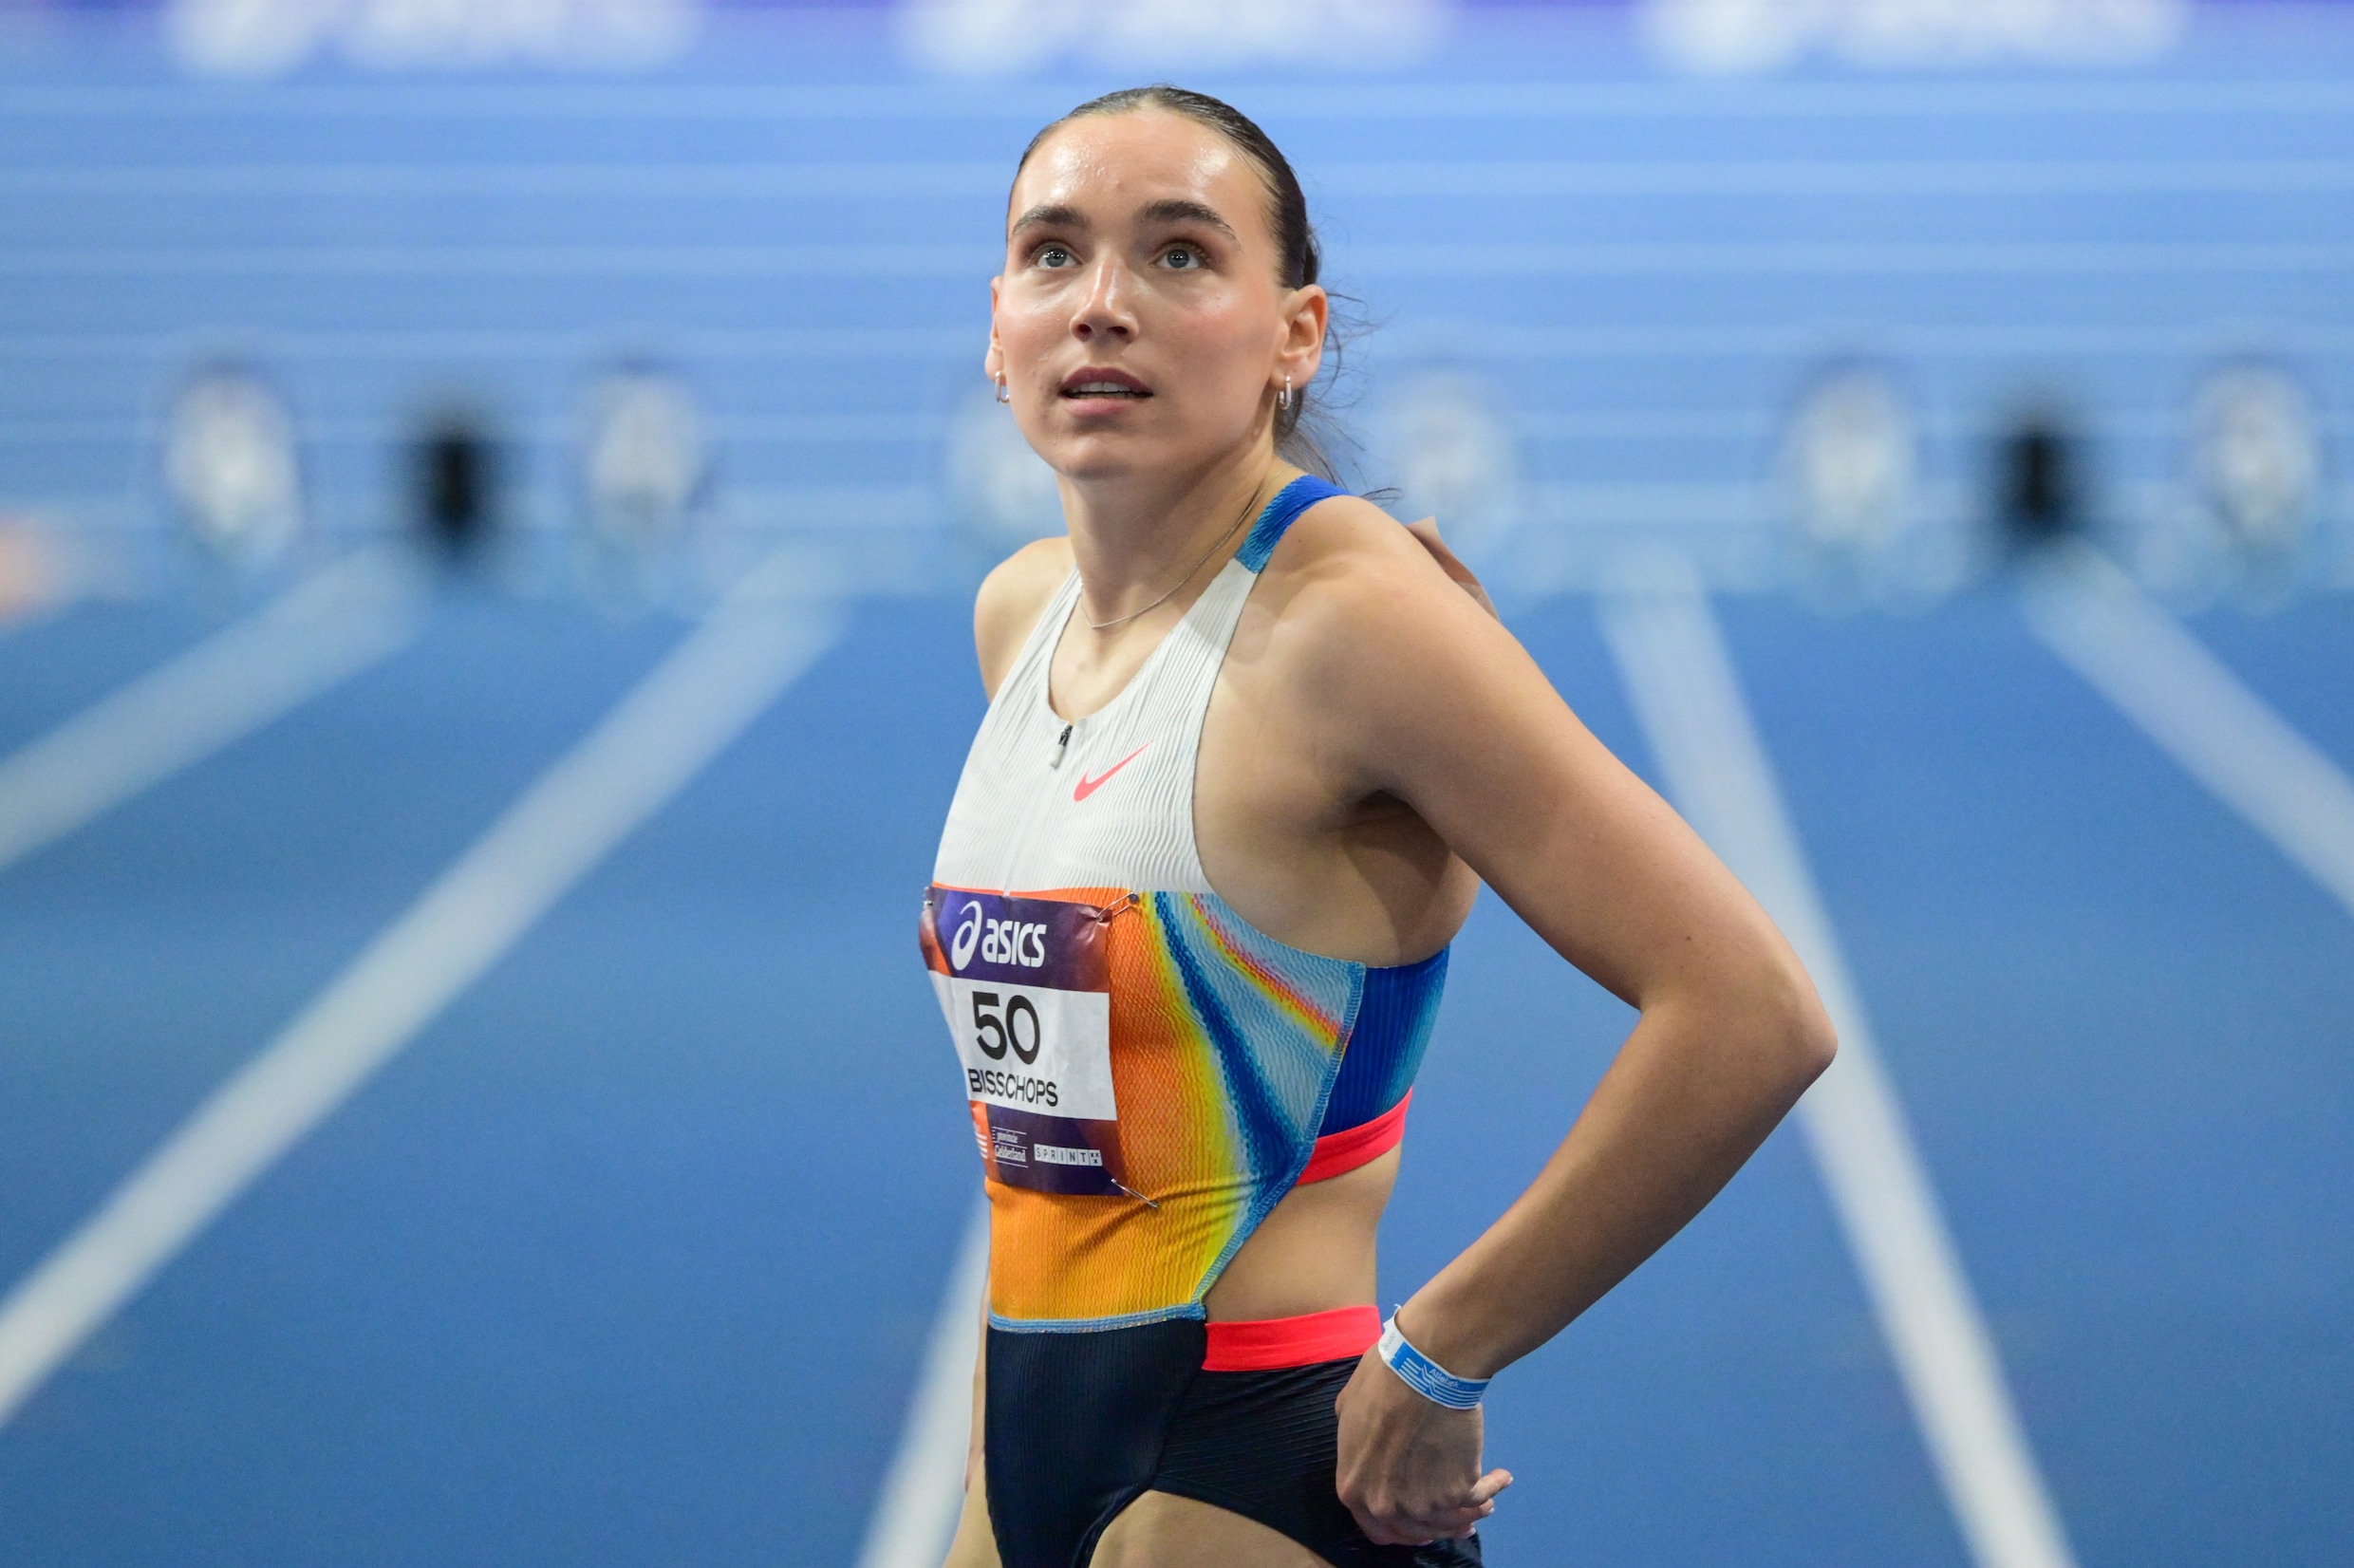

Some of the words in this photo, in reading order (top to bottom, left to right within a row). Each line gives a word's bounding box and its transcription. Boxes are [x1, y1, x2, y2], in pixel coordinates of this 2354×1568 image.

[982, 919, 1046, 967] asics
[972, 991, 1040, 1064] 50
[968, 1070, 1057, 1106] BISSCHOPS
